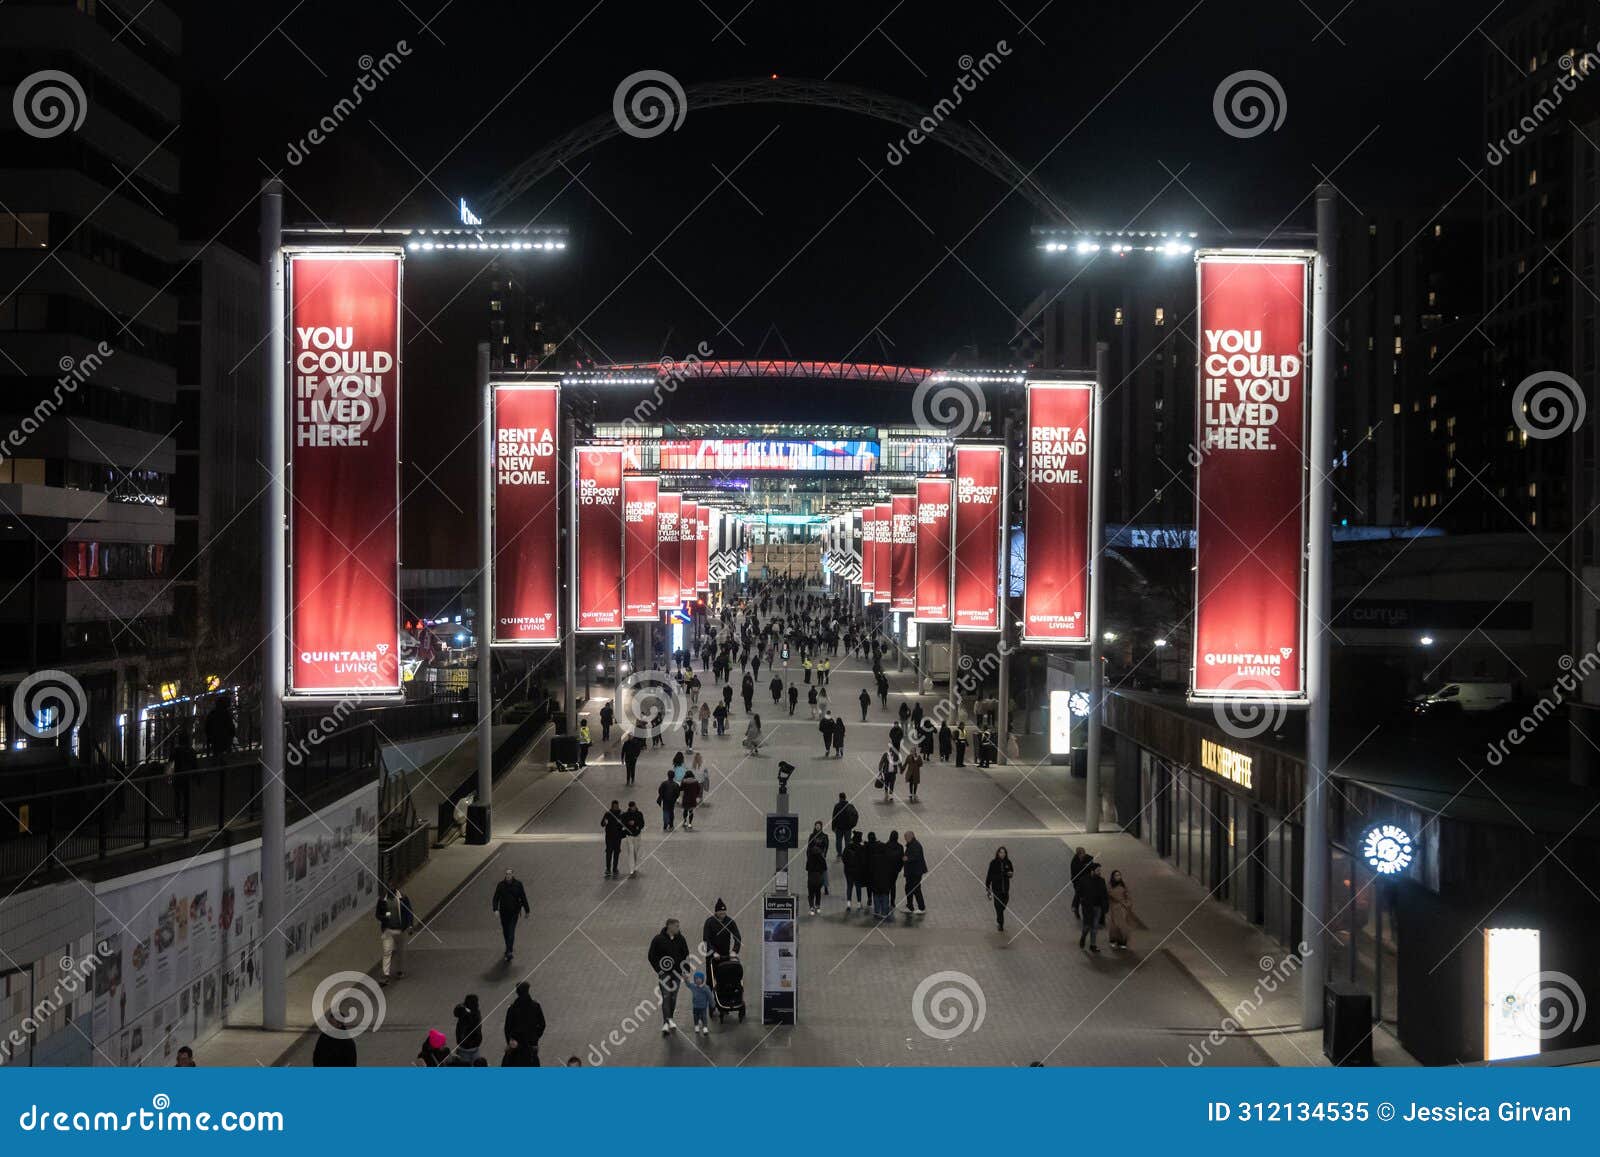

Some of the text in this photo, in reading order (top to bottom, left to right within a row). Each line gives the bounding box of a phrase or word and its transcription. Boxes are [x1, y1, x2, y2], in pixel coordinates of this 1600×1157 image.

[296, 326, 353, 350] YOU
[1205, 329, 1262, 353] YOU
[297, 351, 393, 374] COULD
[1205, 353, 1300, 378] COULD
[297, 375, 382, 398] IF YOU
[1205, 378, 1290, 402] IF YOU
[297, 399, 371, 423] LIVED
[1205, 402, 1279, 426] LIVED
[297, 424, 368, 447] HERE.
[498, 428, 553, 442] RENT A
[1031, 426, 1087, 441] RENT A
[1205, 427, 1277, 450] HERE.
[498, 442, 553, 456] BRAND
[1031, 441, 1087, 455] BRAND
[498, 457, 534, 470] NEW
[1031, 455, 1067, 469] NEW
[498, 471, 550, 485] HOME.
[580, 479, 596, 487] NO
[958, 477, 974, 486] NO
[1031, 469, 1083, 483] HOME.
[580, 487, 620, 496] DEPOSIT
[958, 486, 998, 495] DEPOSIT
[580, 496, 615, 505] TO PAY.
[958, 495, 992, 504] TO PAY.
[500, 617, 545, 625] QUINTAIN
[520, 623, 545, 631] LIVING
[301, 651, 377, 663] QUINTAIN
[1204, 653, 1280, 666] QUINTAIN
[334, 663, 377, 673] LIVING
[1237, 666, 1280, 676] LIVING
